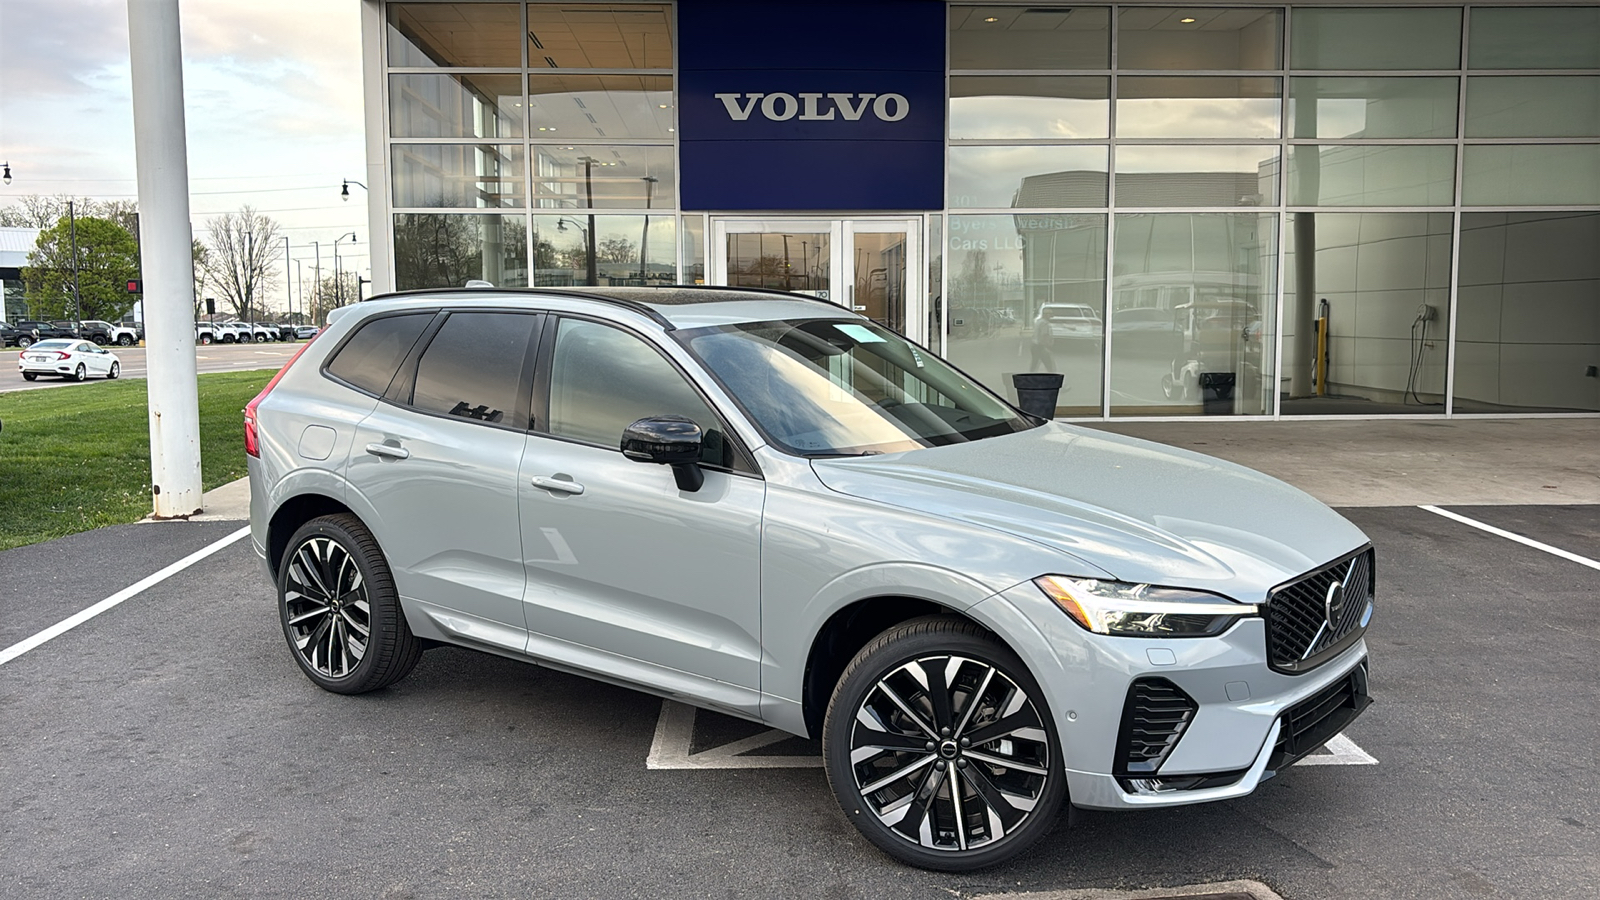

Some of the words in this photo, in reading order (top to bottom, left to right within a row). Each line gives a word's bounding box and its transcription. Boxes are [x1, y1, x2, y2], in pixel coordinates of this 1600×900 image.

[714, 92, 910, 122] VOLVO
[949, 236, 988, 251] Cars
[994, 236, 1028, 251] LLC
